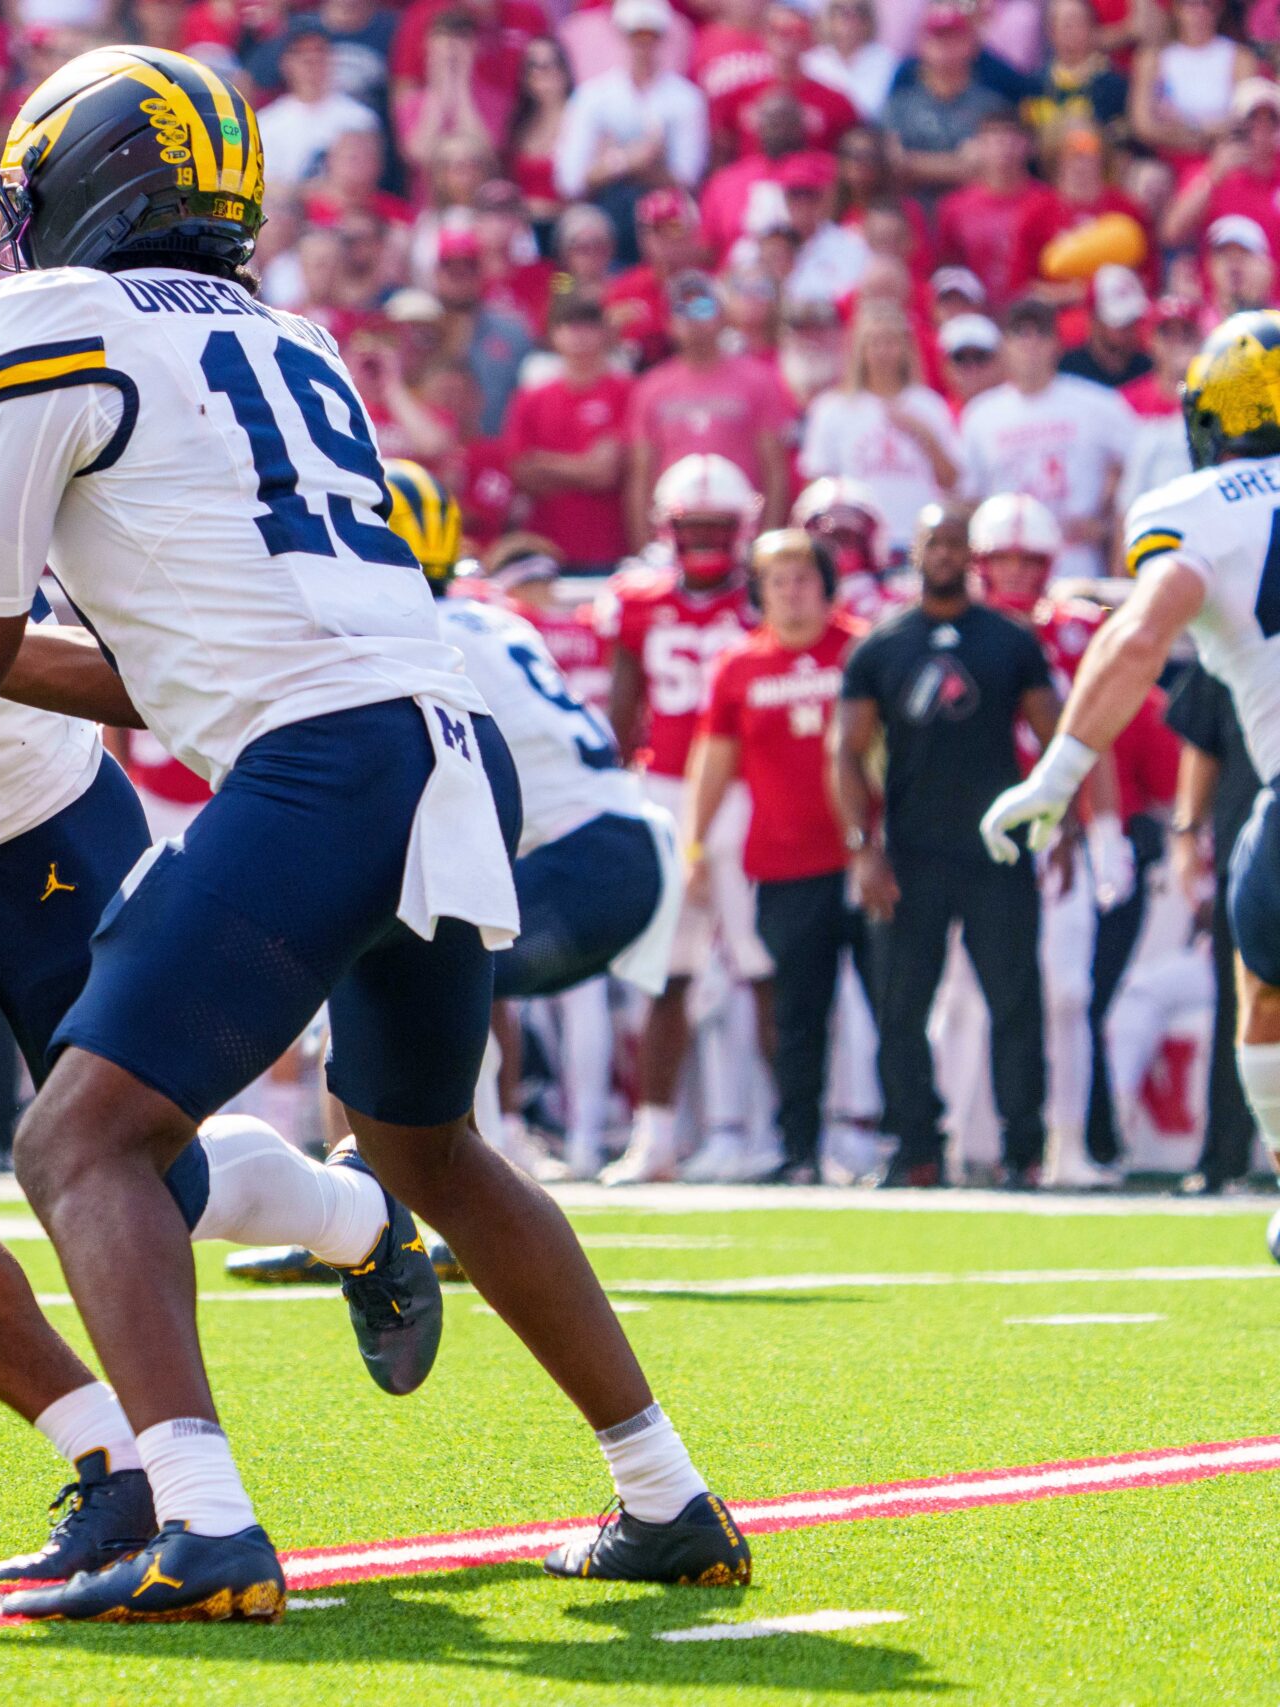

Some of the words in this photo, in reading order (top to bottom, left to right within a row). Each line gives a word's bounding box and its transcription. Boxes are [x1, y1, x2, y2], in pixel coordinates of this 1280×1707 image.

[223, 123, 241, 135] C2P
[166, 150, 187, 163] TED
[176, 167, 193, 186] 19
[200, 330, 420, 570] 19
[433, 704, 472, 763] M
